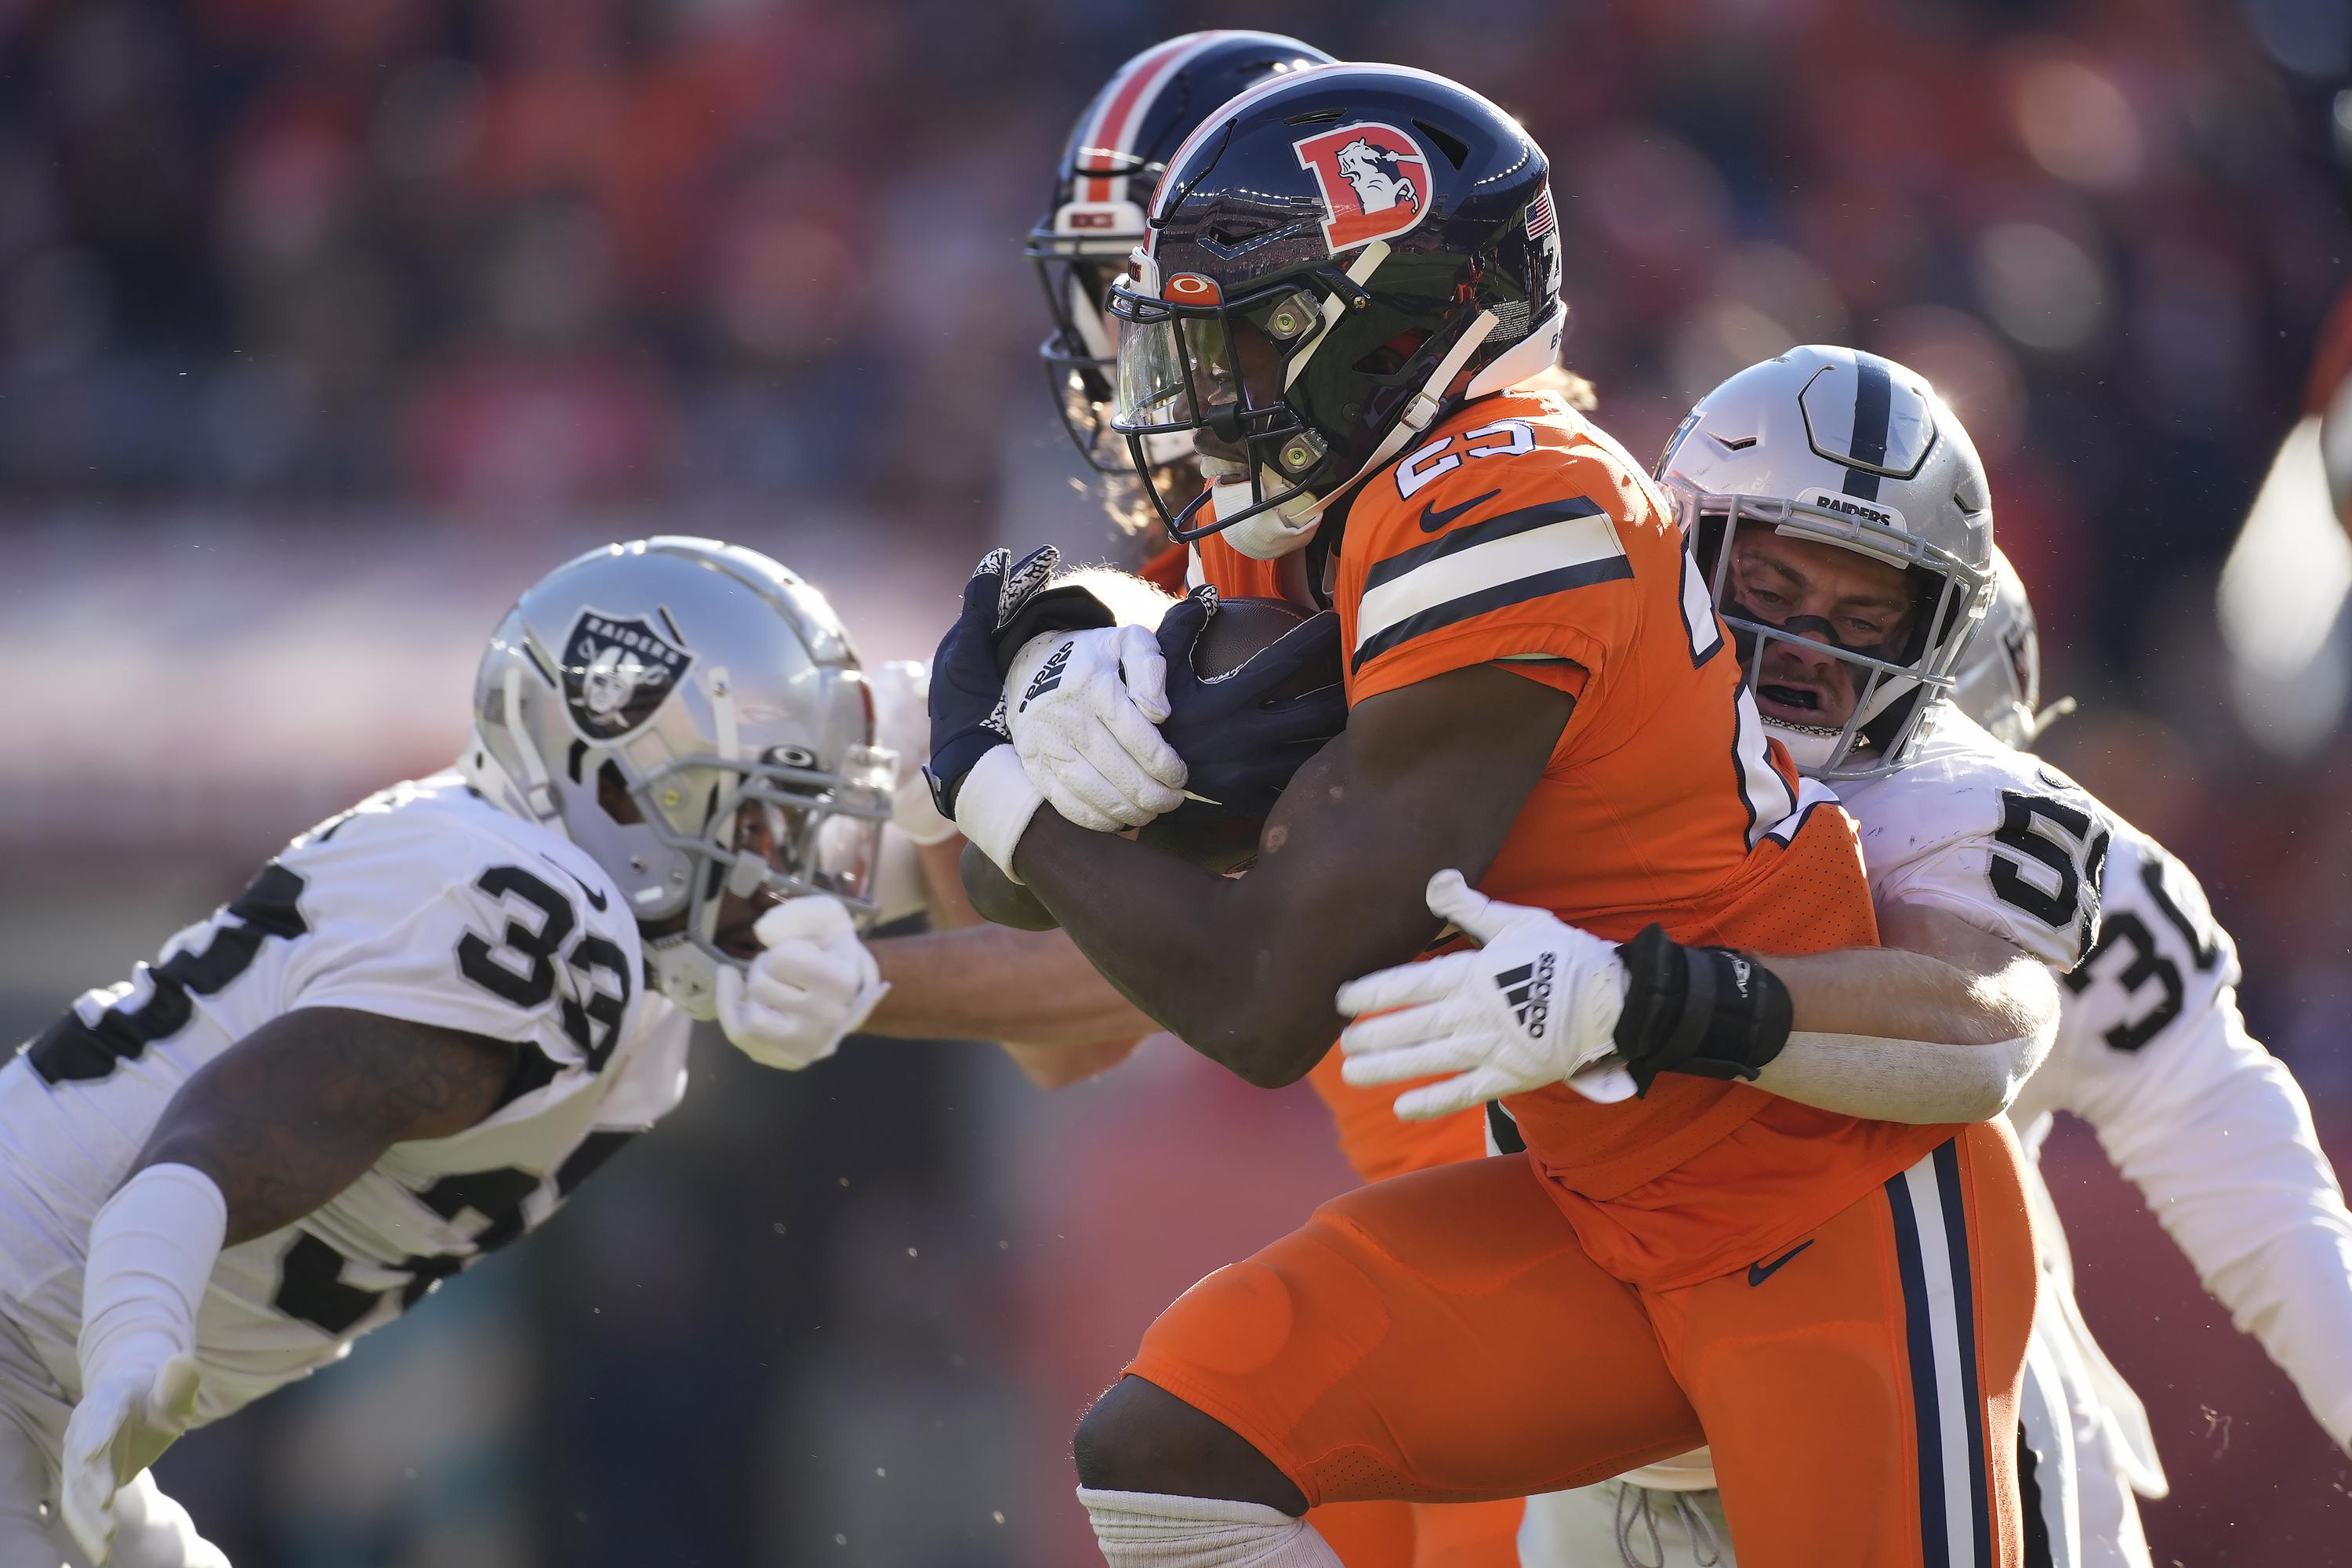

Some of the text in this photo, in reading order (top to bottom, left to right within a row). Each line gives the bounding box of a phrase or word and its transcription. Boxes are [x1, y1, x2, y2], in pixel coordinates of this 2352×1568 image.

[1493, 299, 1519, 309] WARNING
[1817, 495, 1891, 526] RAIDERS
[586, 617, 679, 666] RAIDERS
[456, 864, 632, 1073] 33
[1528, 951, 1557, 1039] adidas
